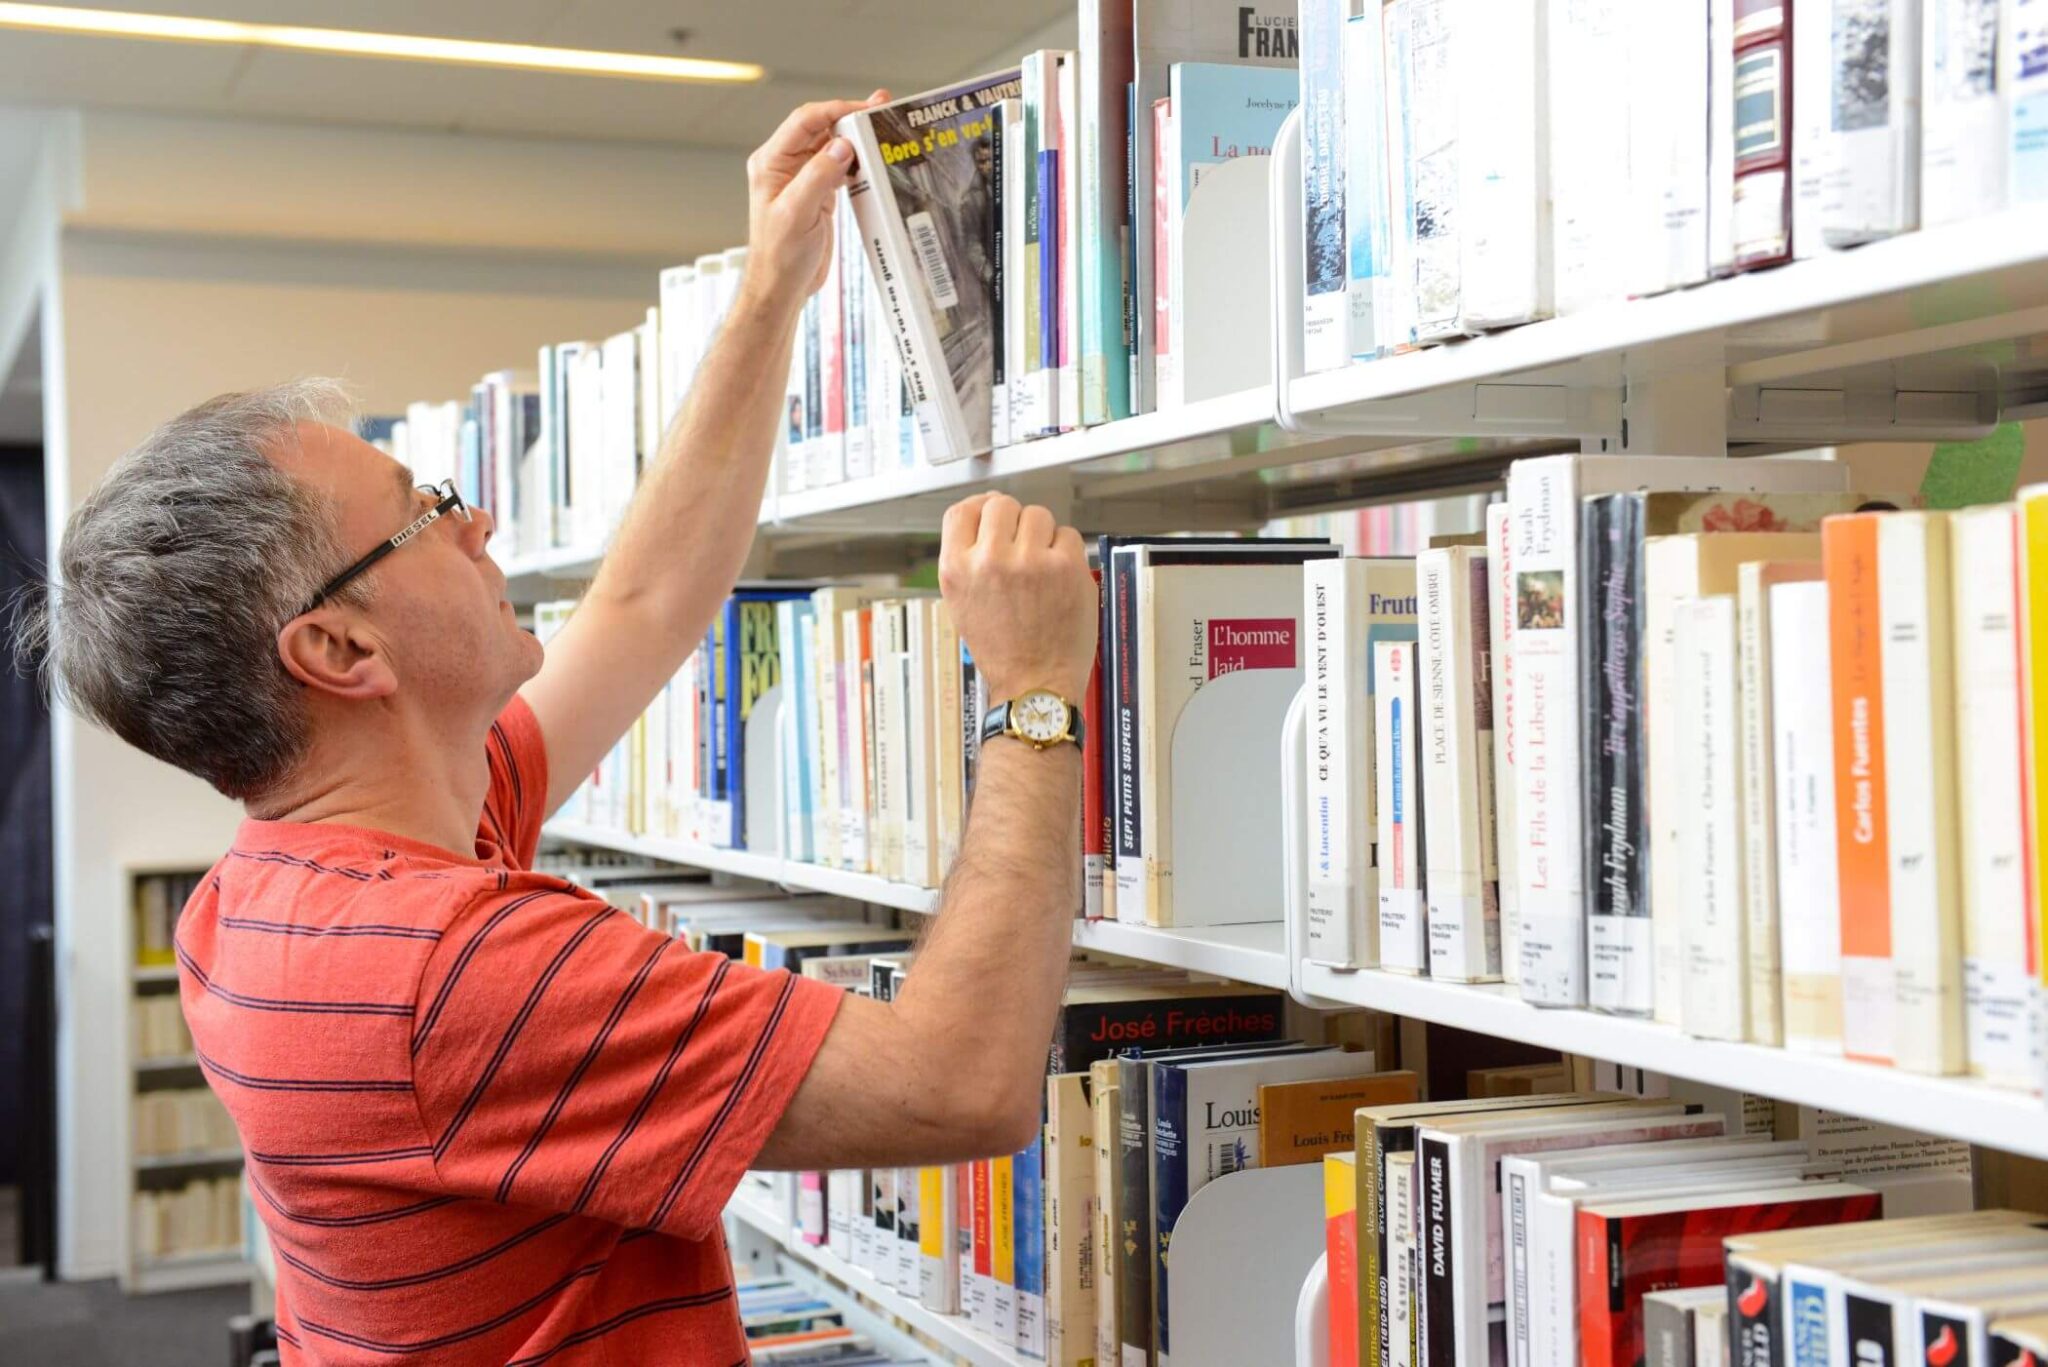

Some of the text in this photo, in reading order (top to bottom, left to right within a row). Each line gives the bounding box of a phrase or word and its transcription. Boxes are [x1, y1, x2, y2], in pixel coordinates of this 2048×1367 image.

[1256, 15, 1299, 27] LUCIE
[907, 77, 1022, 128] FRANCK & VAUTRI
[1246, 98, 1285, 111] Jocelyne
[880, 140, 920, 165] Boro
[923, 128, 957, 151] s'en
[1211, 136, 1239, 158] La
[873, 238, 894, 282] guerre
[913, 371, 927, 402] Boro
[393, 512, 437, 545] DIESEL
[1519, 507, 1534, 557] Sarah
[1536, 475, 1554, 556] Frydman
[1428, 570, 1439, 615] OMBRE
[1190, 619, 1203, 667] Fraser
[1214, 626, 1290, 646] L'homme
[1214, 656, 1245, 676] laid
[1315, 583, 1330, 781] CE QU'A VU LE VENT D'OUEST
[1434, 703, 1444, 719] DE
[1527, 672, 1546, 746] Liberté
[1434, 724, 1446, 765] PLACE
[1850, 696, 1872, 778] Fuentes
[1122, 708, 1134, 849] SEPT PETITS SUSPECTS
[1528, 754, 1546, 772] la
[1528, 779, 1547, 805] de
[1853, 780, 1873, 843] Carlos
[1319, 796, 1329, 857] Lucentini
[1529, 818, 1547, 848] Fils
[1603, 786, 1635, 872] Frydman
[1530, 857, 1548, 890] Les
[1091, 1013, 1157, 1041] José
[1206, 1099, 1261, 1129] Louis
[1294, 1132, 1329, 1147] Louis
[1364, 1127, 1374, 1167] Fuller
[1376, 1140, 1384, 1192] CHAPUT
[1365, 1171, 1375, 1238] Alexandra
[1394, 1175, 1407, 1244] FULLER
[1430, 1156, 1445, 1278] DAVID FULMER
[1366, 1255, 1379, 1301] pierre
[1368, 1303, 1377, 1320] de
[1379, 1275, 1390, 1348] (1810-1850)
